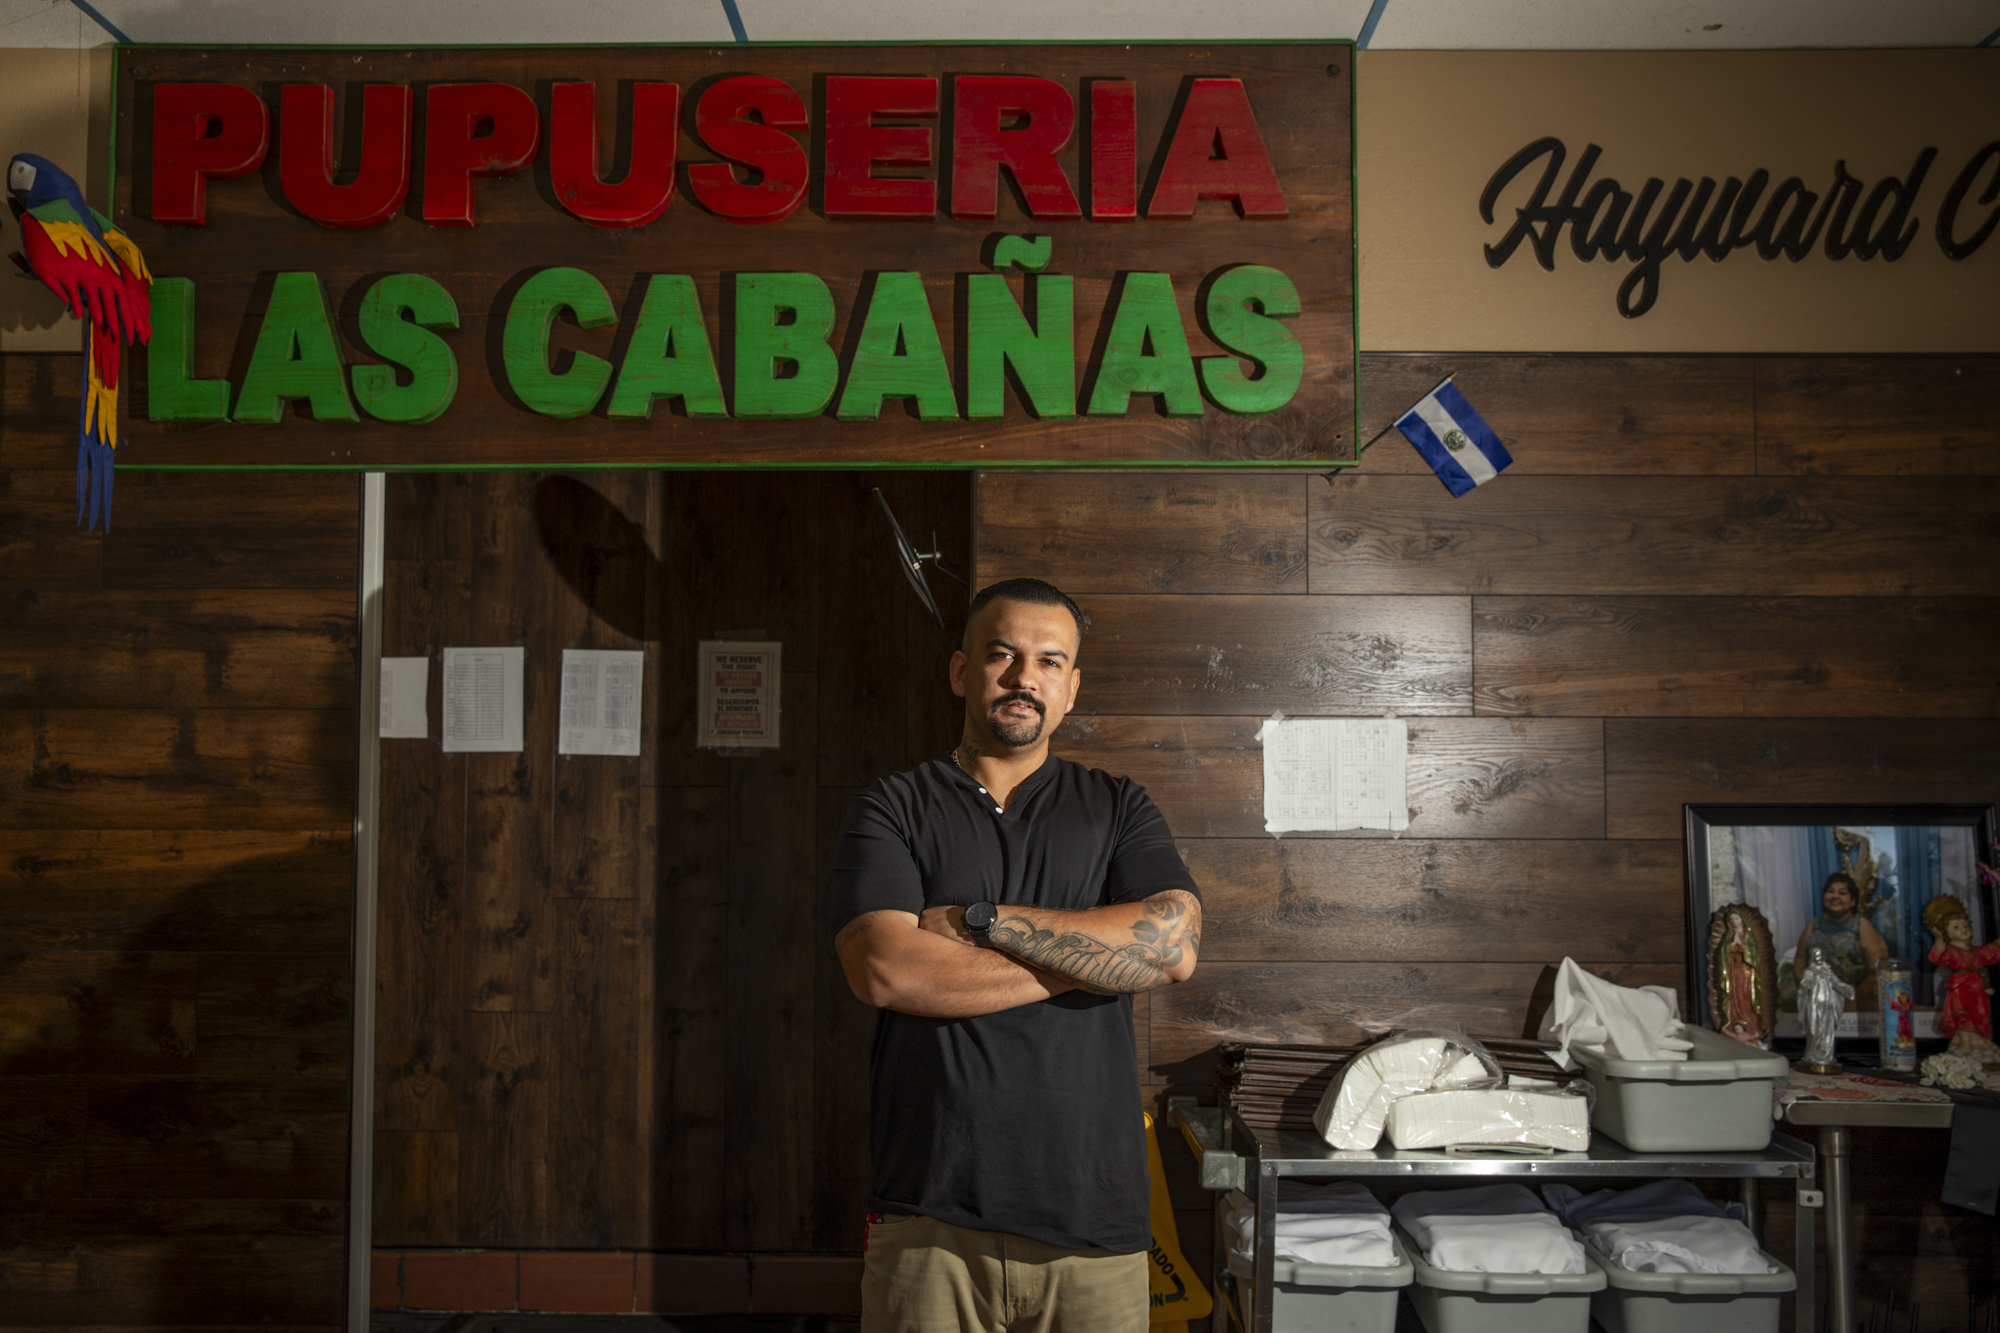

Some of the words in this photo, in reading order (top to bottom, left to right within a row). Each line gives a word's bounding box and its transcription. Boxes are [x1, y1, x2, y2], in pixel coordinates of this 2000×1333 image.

[151, 74, 1290, 229] PUPUSERIA
[1478, 135, 1939, 320] Hayward
[147, 271, 460, 425] LAS
[502, 233, 1305, 421] CABAÑAS
